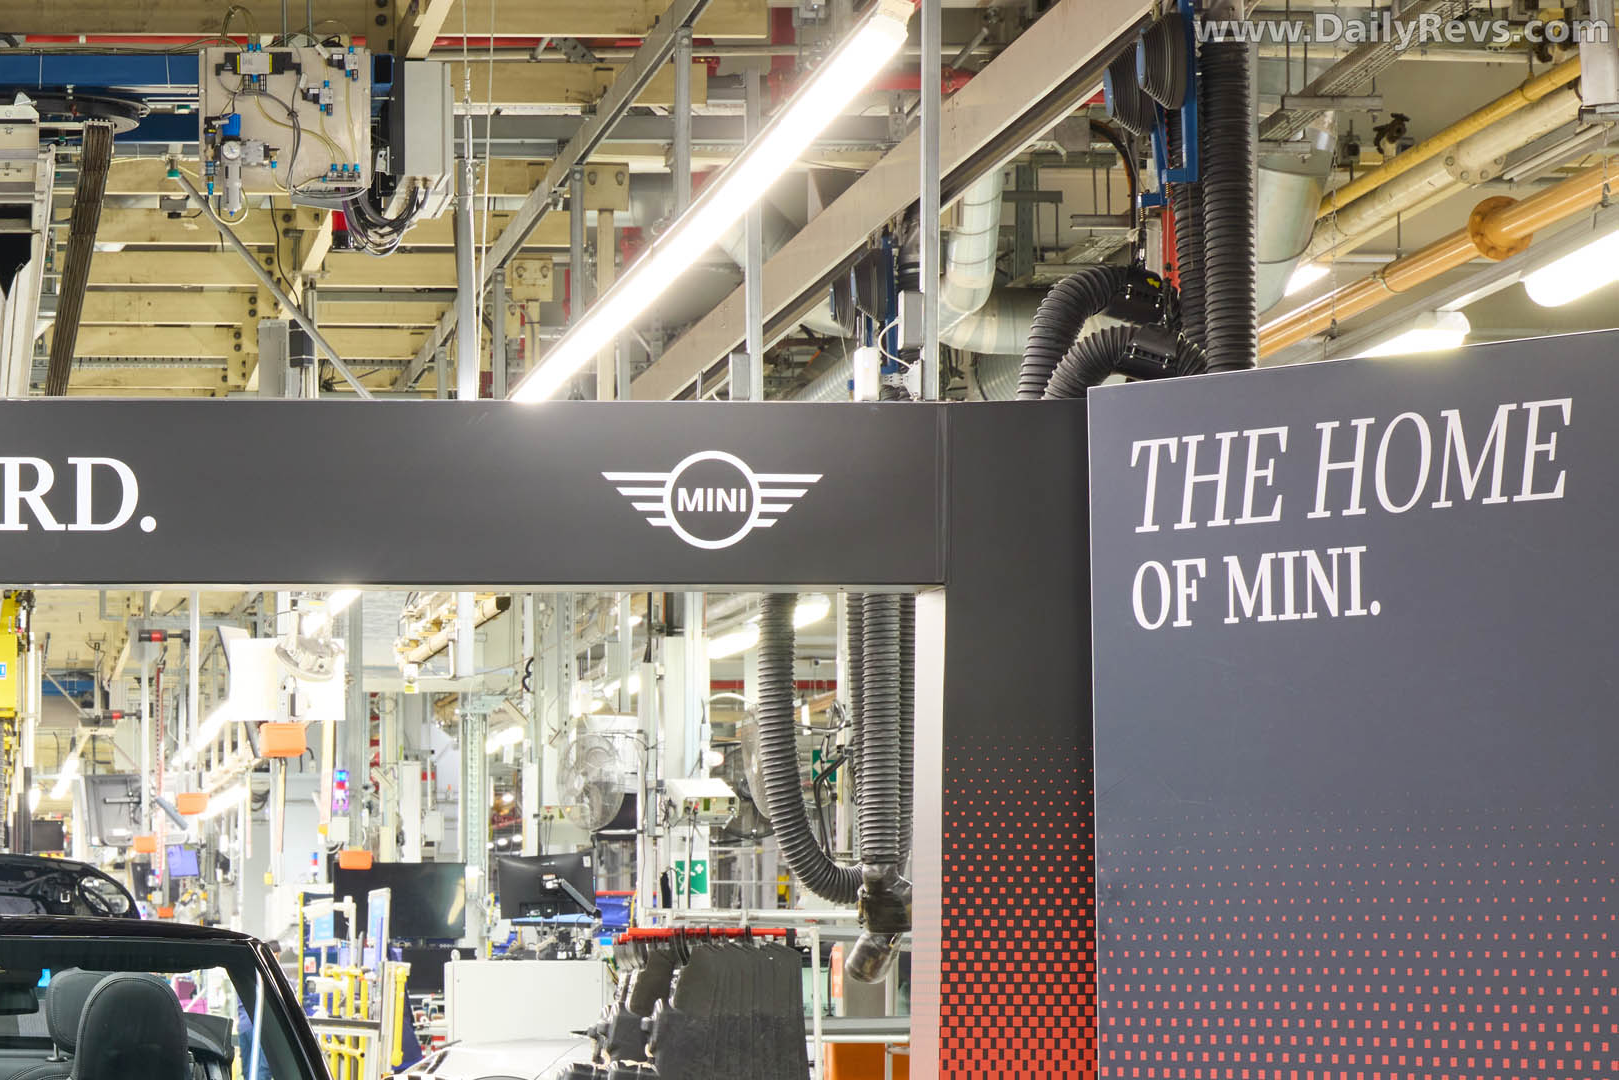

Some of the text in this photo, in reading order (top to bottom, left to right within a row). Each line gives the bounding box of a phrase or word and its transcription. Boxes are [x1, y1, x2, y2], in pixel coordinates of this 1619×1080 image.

[677, 487, 747, 513] MINI
[1130, 397, 1573, 533] THE HOME
[1131, 545, 1382, 631] OF MINI.
